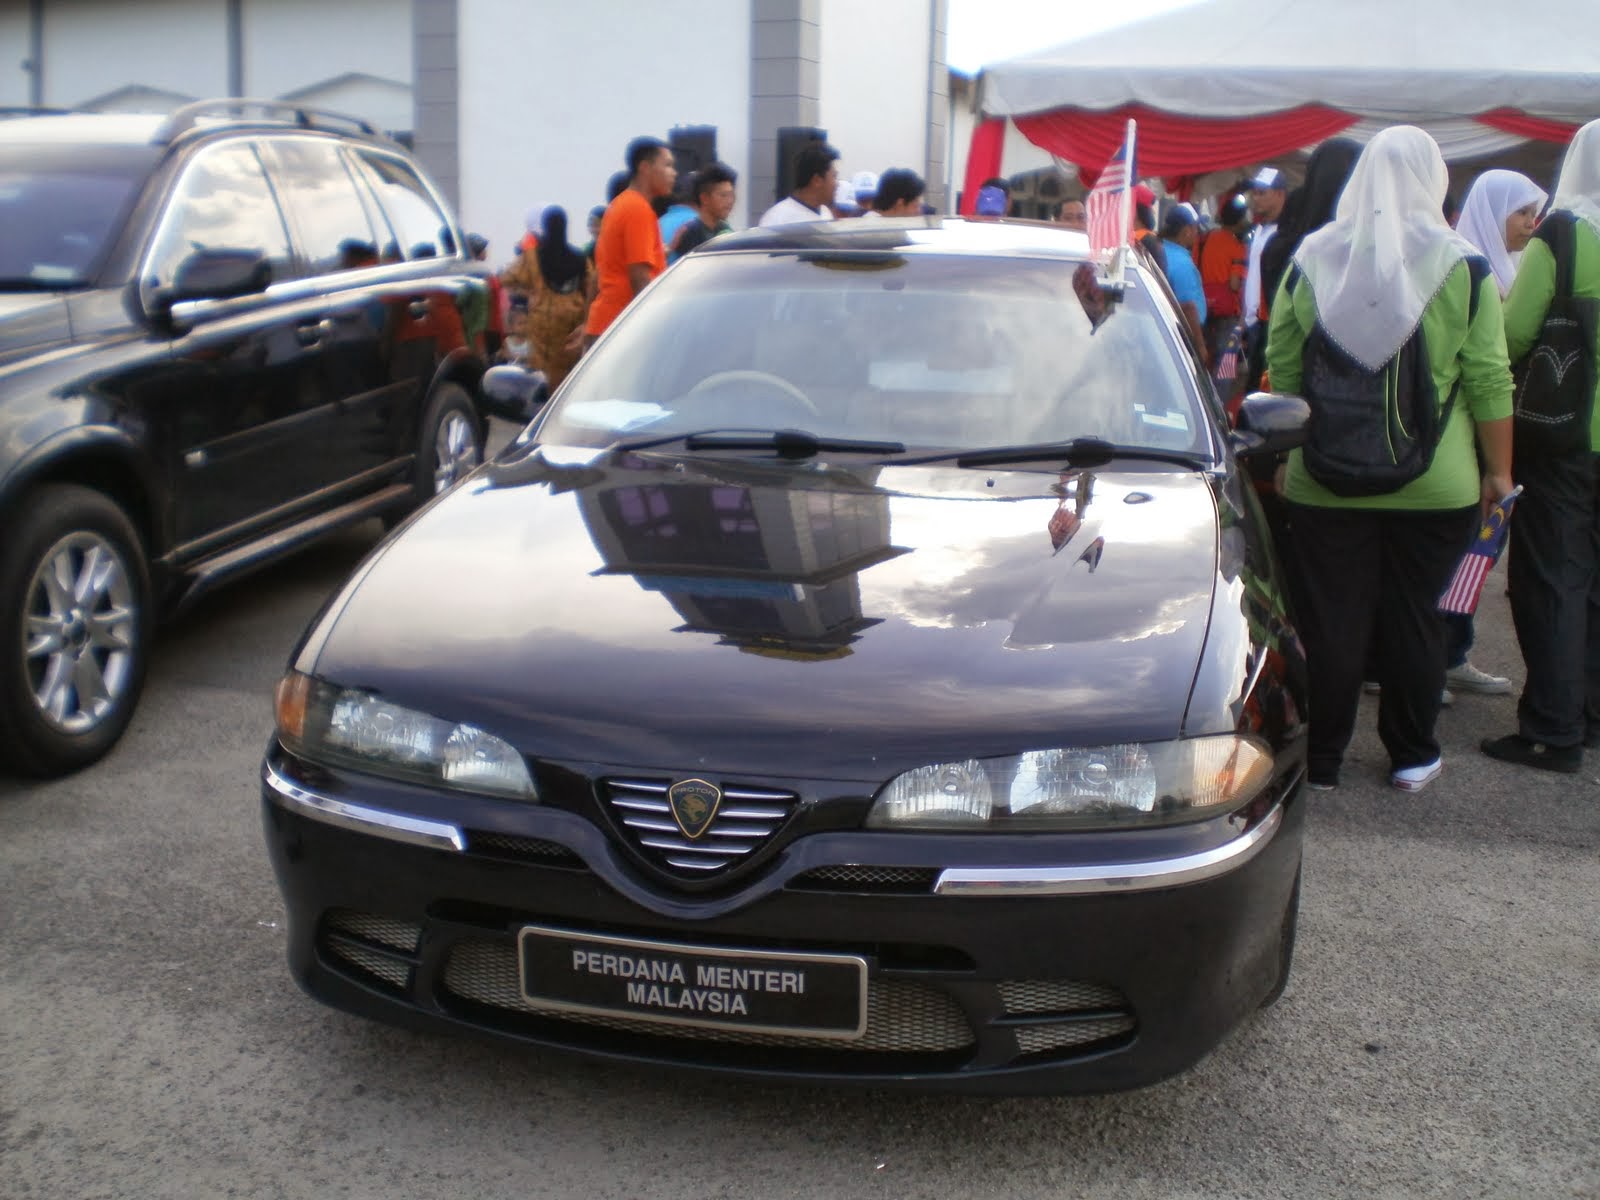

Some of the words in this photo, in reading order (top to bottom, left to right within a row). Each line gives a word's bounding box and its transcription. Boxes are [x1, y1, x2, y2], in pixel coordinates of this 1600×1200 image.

[674, 786, 716, 797] PROTON
[572, 950, 685, 984] PERDANA
[697, 965, 805, 995] MENTERI
[627, 983, 748, 1015] MALAYSIA
